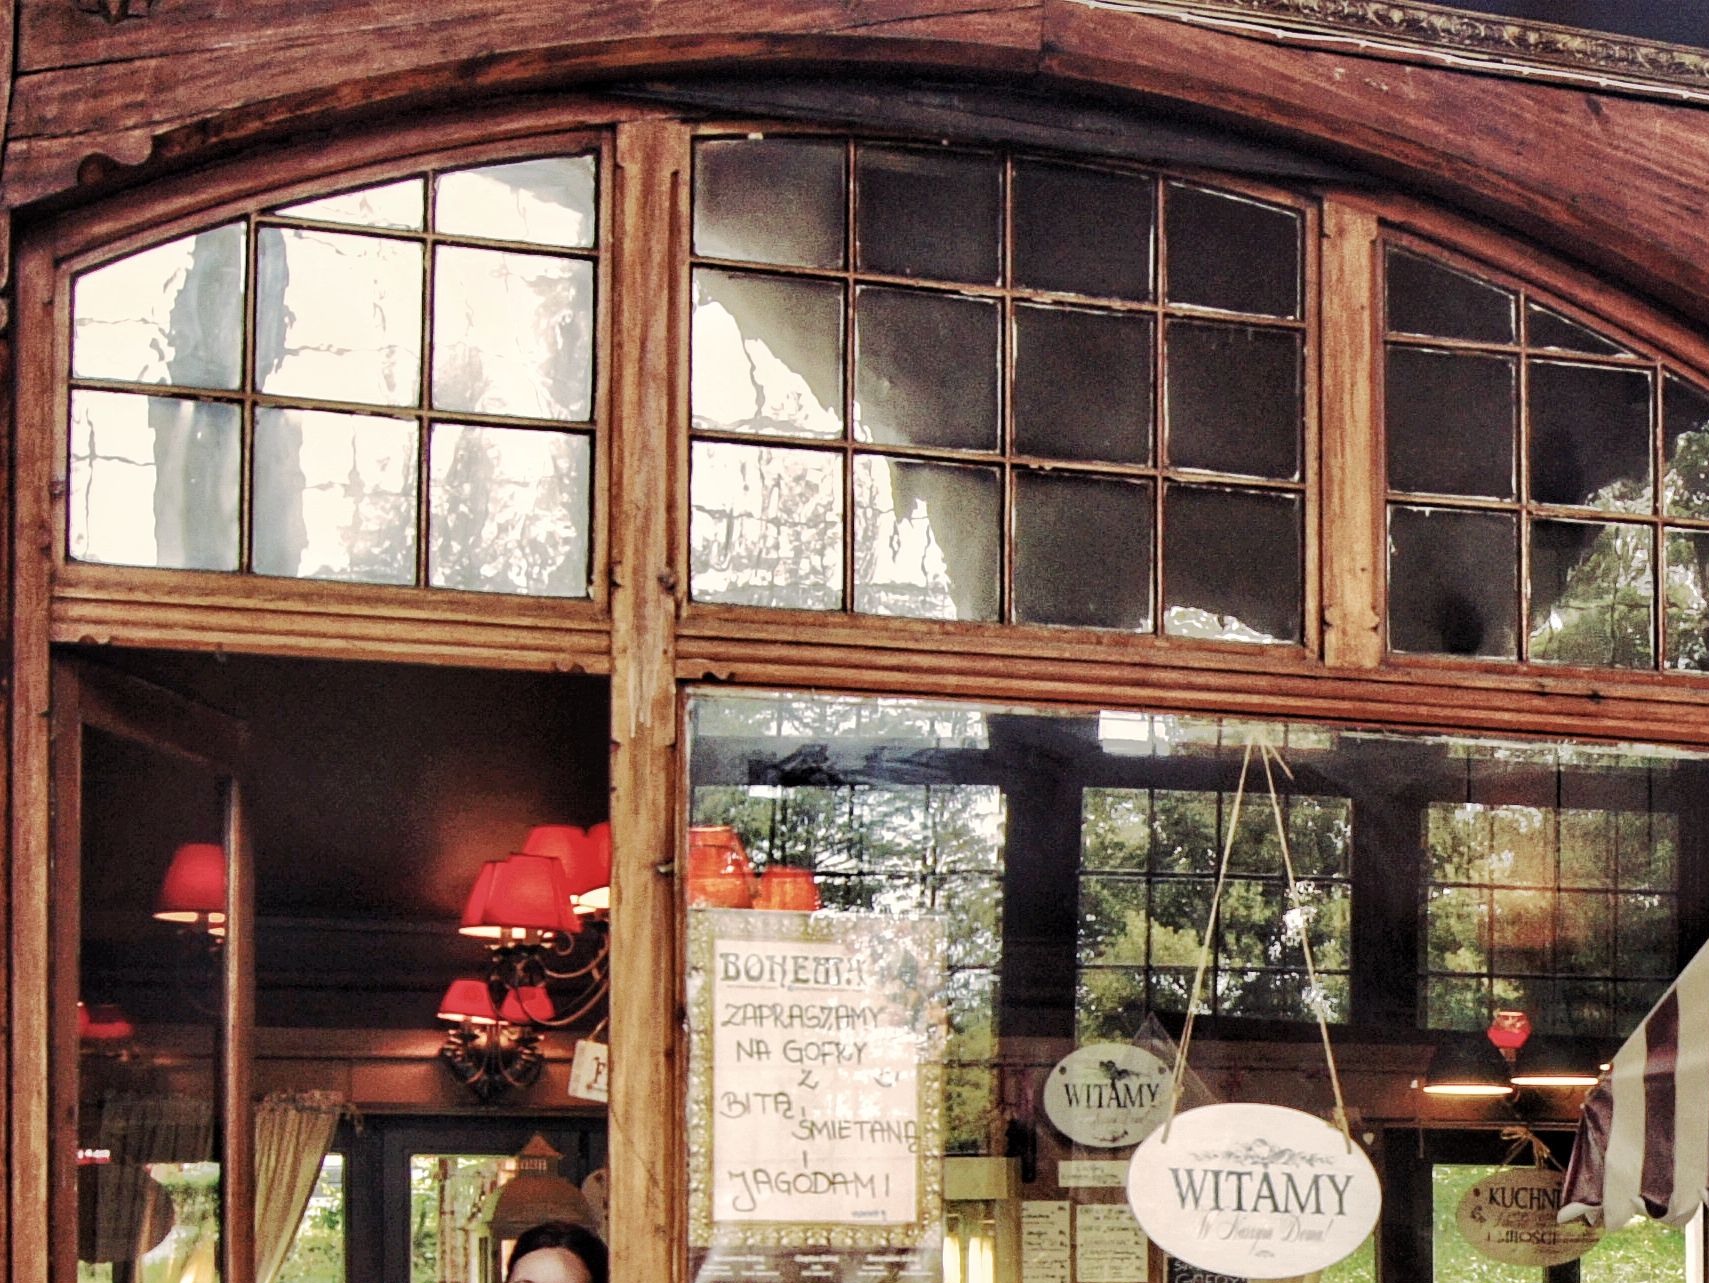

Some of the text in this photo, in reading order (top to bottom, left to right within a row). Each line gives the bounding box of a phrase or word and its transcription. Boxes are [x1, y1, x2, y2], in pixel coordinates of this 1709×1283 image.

[720, 1002, 888, 1031] ZAPRASZAMY
[736, 1038, 771, 1063] NA
[719, 1090, 795, 1120] BITĄ
[1064, 1079, 1160, 1109] WITAMY
[791, 1106, 921, 1153] ŚMIETANĄ
[728, 1168, 891, 1213] JAGODAMI
[1168, 1165, 1354, 1217] WITAMY
[1488, 1186, 1564, 1212] KUCHNI
